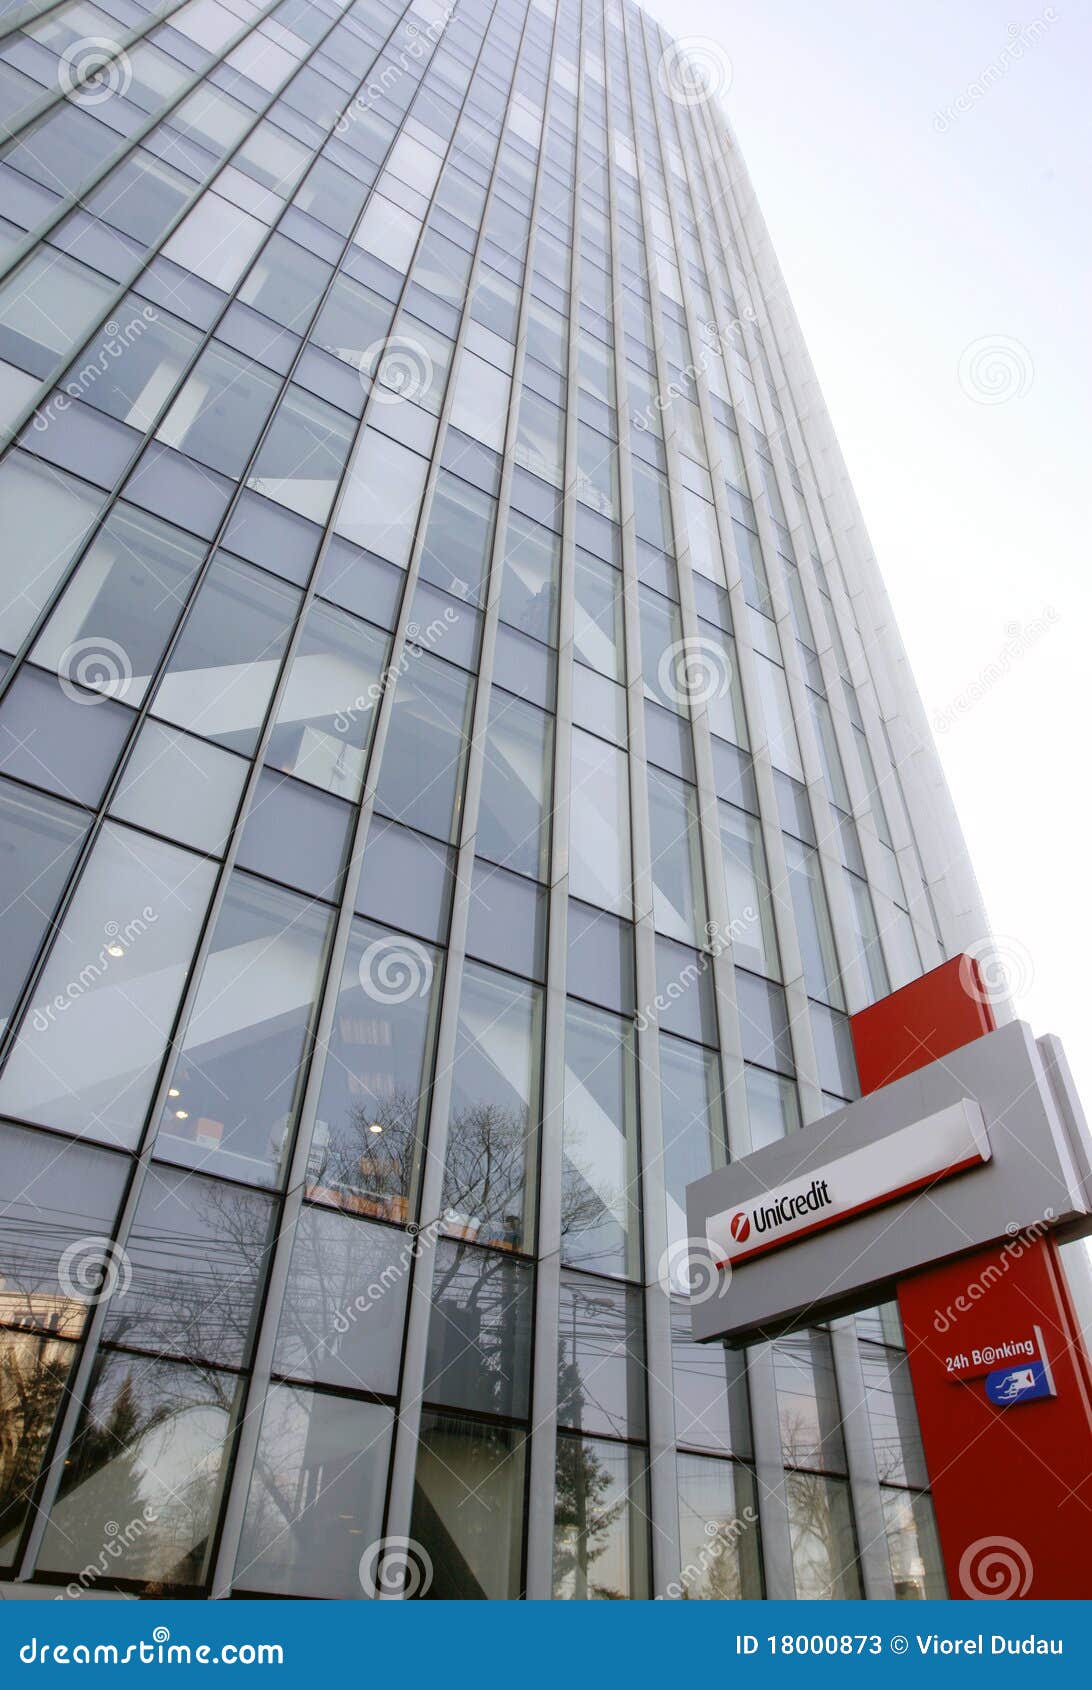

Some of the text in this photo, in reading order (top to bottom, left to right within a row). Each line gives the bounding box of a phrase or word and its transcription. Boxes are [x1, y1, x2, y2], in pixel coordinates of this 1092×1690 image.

[753, 1179, 832, 1233] UniCredit
[946, 1339, 1034, 1372] 24h B@nking
